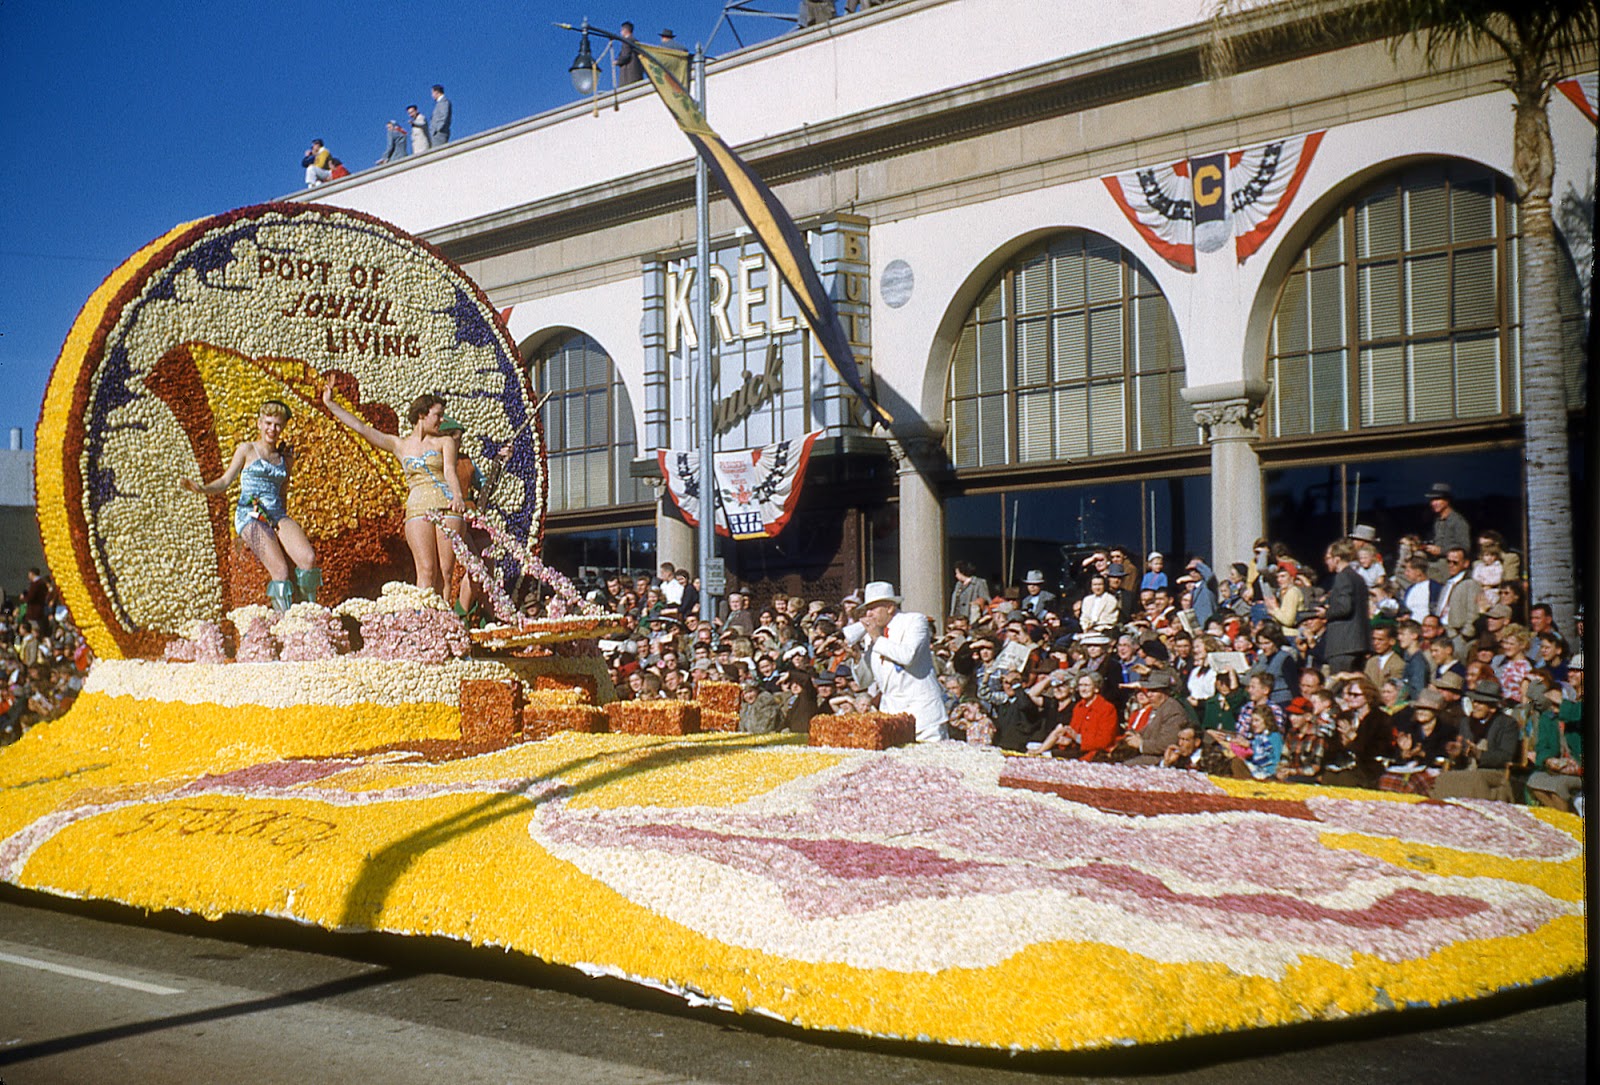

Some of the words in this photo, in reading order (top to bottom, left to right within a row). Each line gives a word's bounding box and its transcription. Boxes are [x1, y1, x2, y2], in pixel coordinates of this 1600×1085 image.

[1193, 164, 1222, 207] C
[258, 256, 333, 285] PORT
[351, 264, 386, 291] OF
[282, 291, 397, 325] JOYFUL
[667, 253, 809, 353] KREL
[327, 328, 421, 358] LIVING
